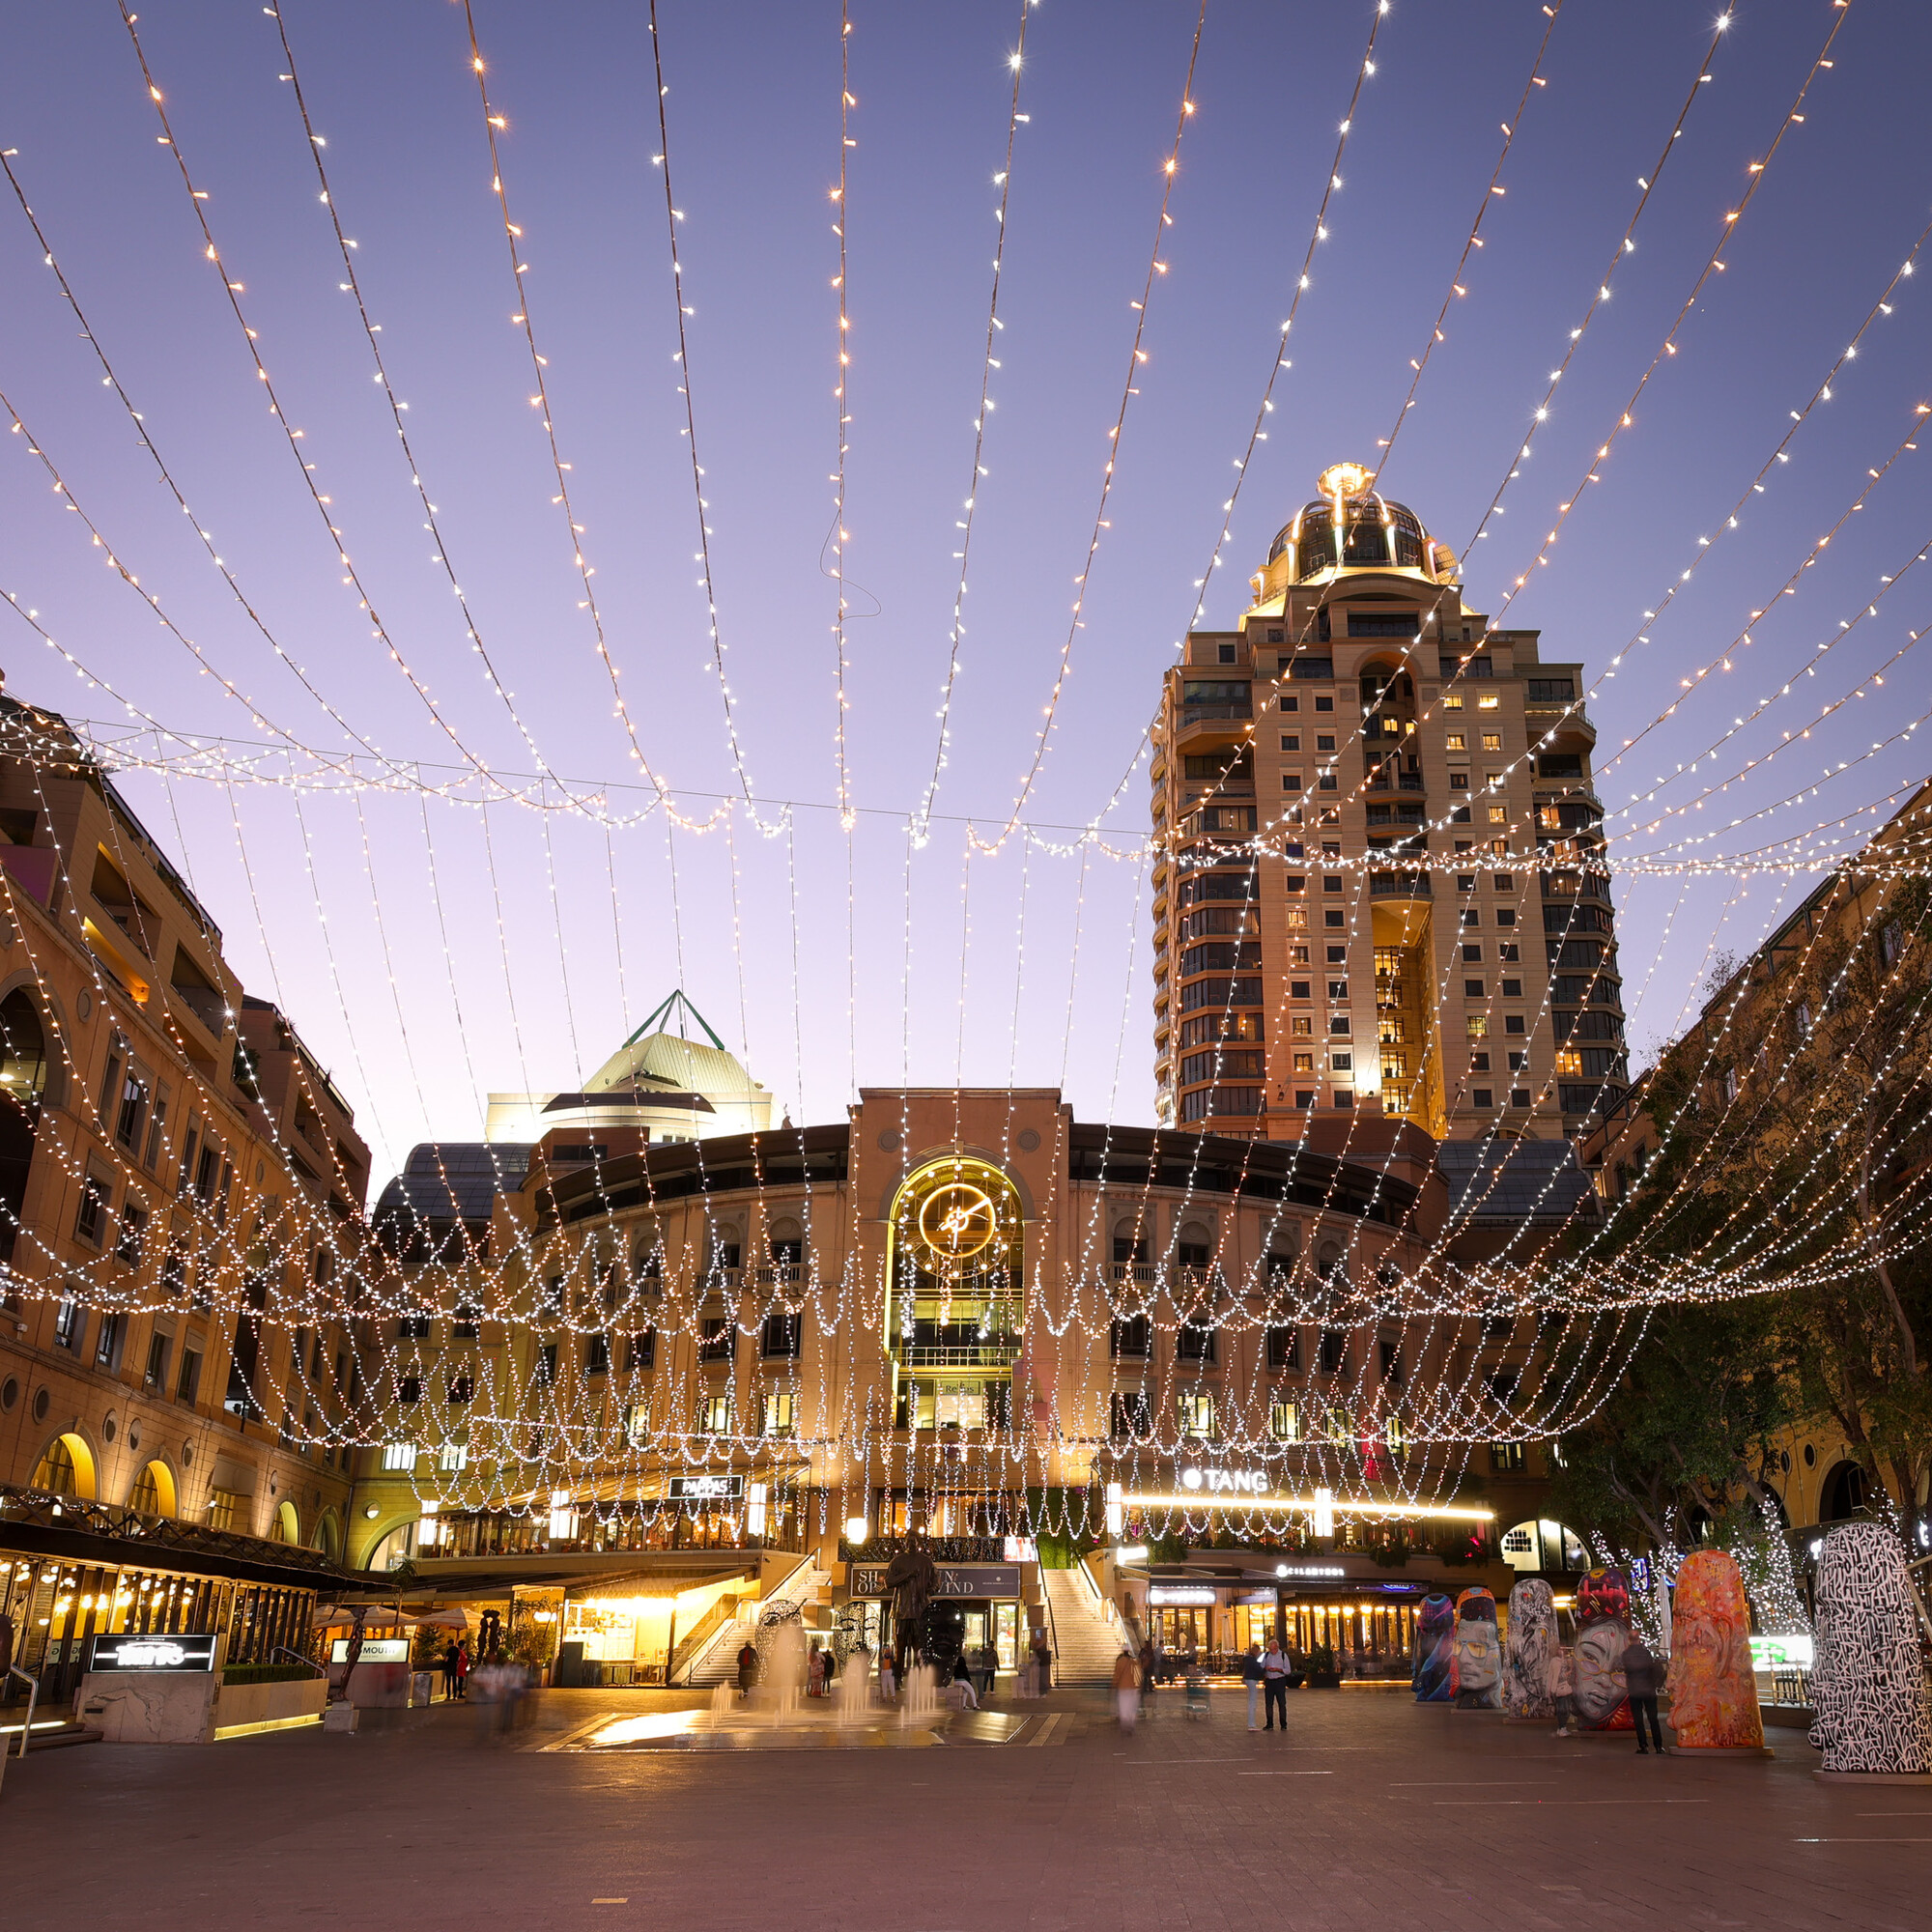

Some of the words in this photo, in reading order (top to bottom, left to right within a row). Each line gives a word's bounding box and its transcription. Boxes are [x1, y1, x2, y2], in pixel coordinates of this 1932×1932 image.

[949, 1465, 1001, 1474] MANDELA
[682, 1479, 728, 1493] PAPPAS
[1204, 1469, 1268, 1492] TANG
